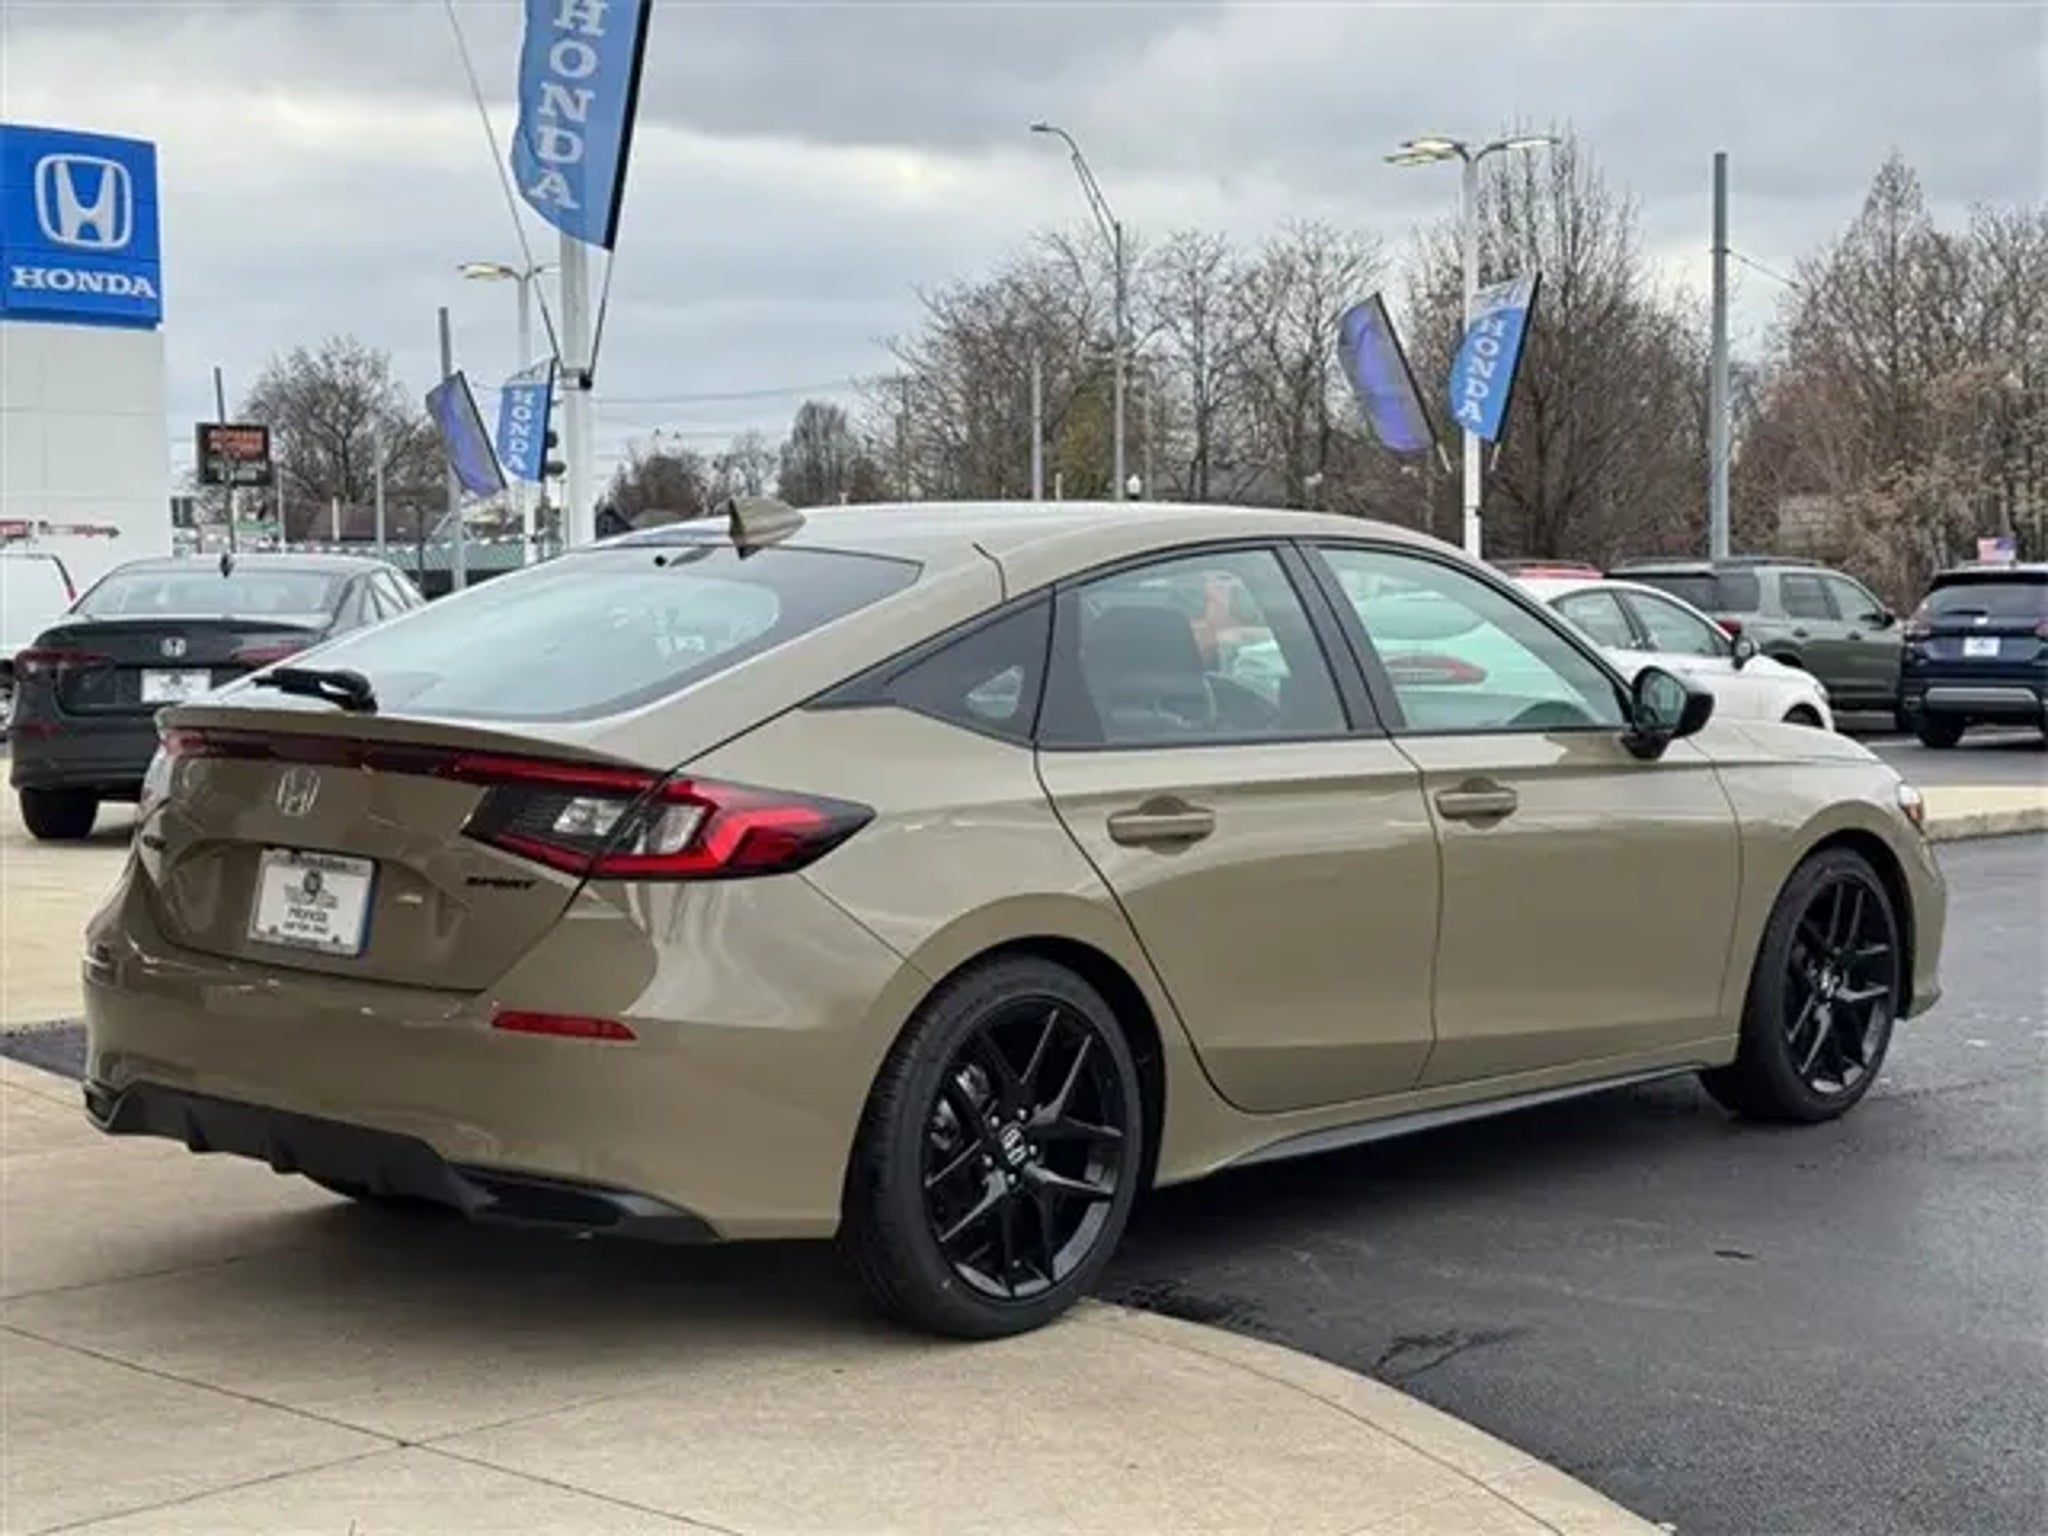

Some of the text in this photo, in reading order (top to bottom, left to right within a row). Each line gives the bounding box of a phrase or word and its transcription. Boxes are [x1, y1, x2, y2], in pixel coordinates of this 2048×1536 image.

[527, 0, 610, 210] HONDA
[11, 265, 158, 299] HONDA
[1456, 317, 1507, 423] HONDA
[508, 389, 535, 471] HONDA
[466, 876, 538, 890] SPORT
